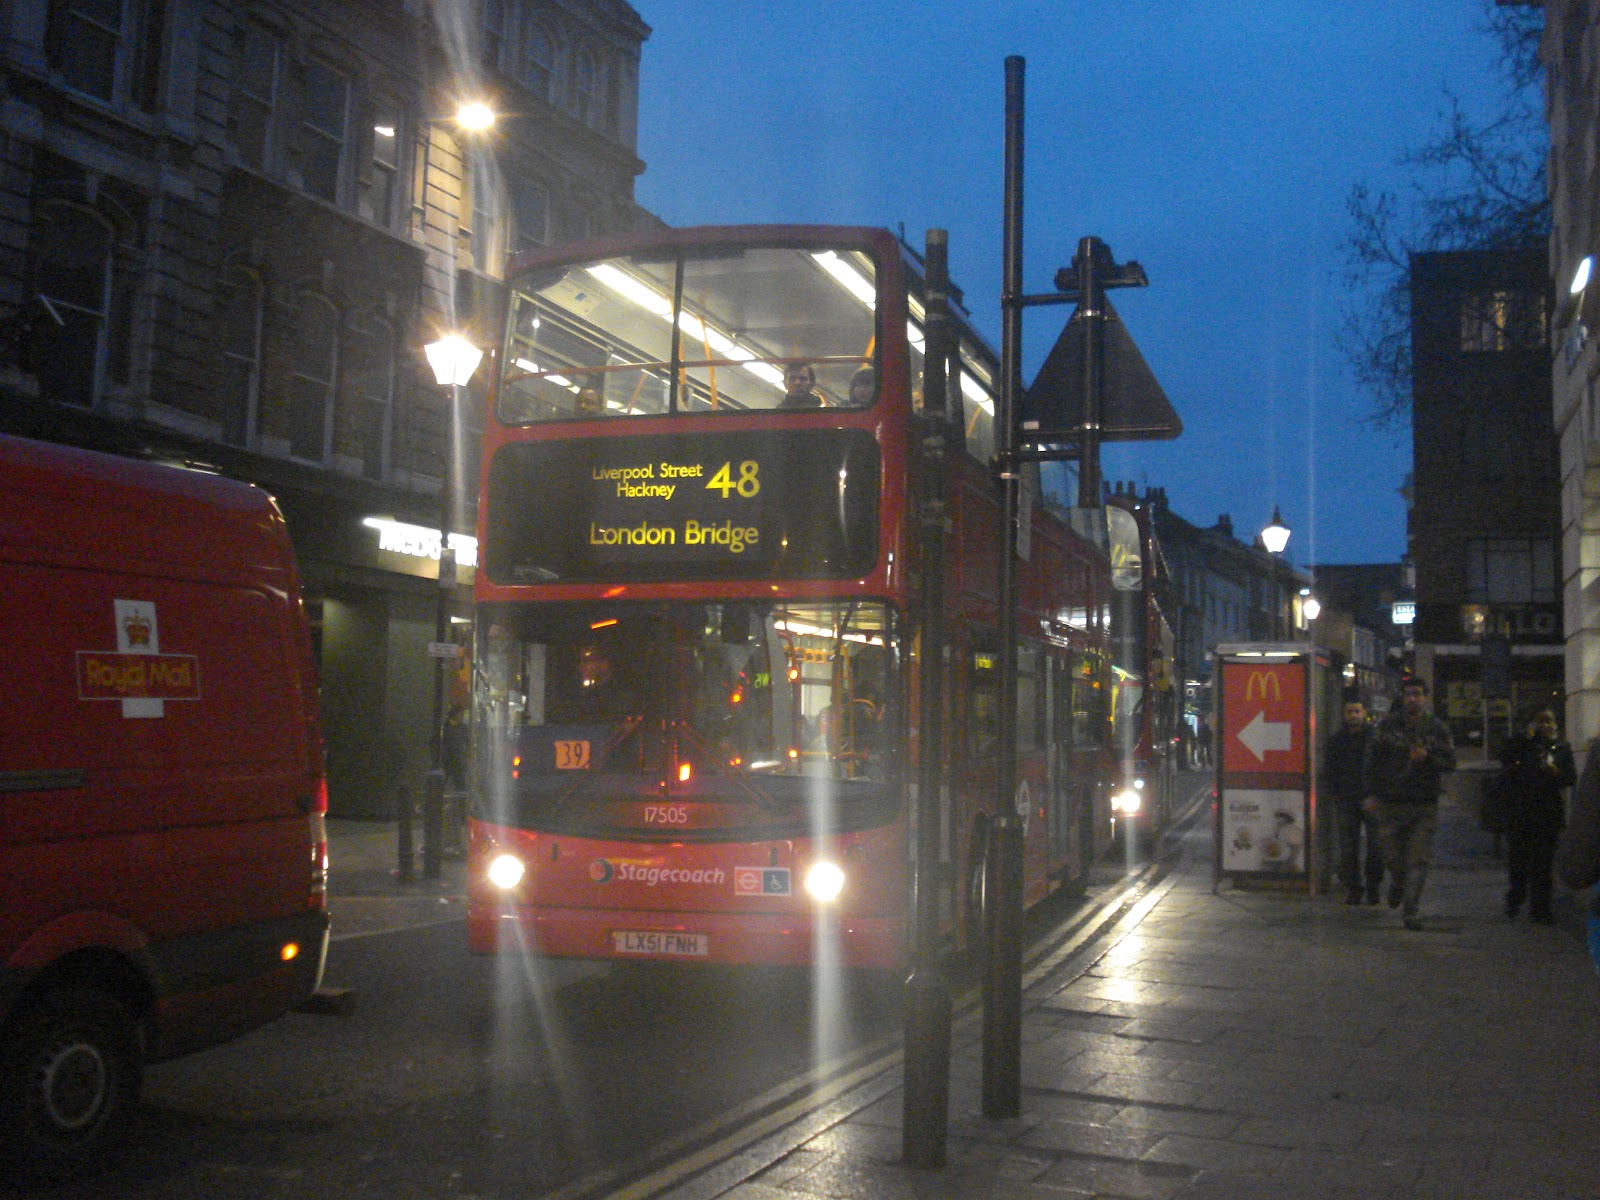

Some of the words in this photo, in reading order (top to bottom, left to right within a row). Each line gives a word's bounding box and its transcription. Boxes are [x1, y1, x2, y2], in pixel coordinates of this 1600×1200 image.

[592, 463, 655, 483] Liverpool
[660, 462, 704, 479] Street
[705, 460, 760, 498] 48
[617, 481, 676, 500] Hackney
[590, 520, 675, 545] London
[685, 519, 759, 553] Bridge
[85, 660, 146, 691] Royal
[563, 742, 584, 767] 39
[644, 806, 688, 824] 17505
[617, 862, 726, 886] Stagecoach
[664, 935, 698, 953] FNH
